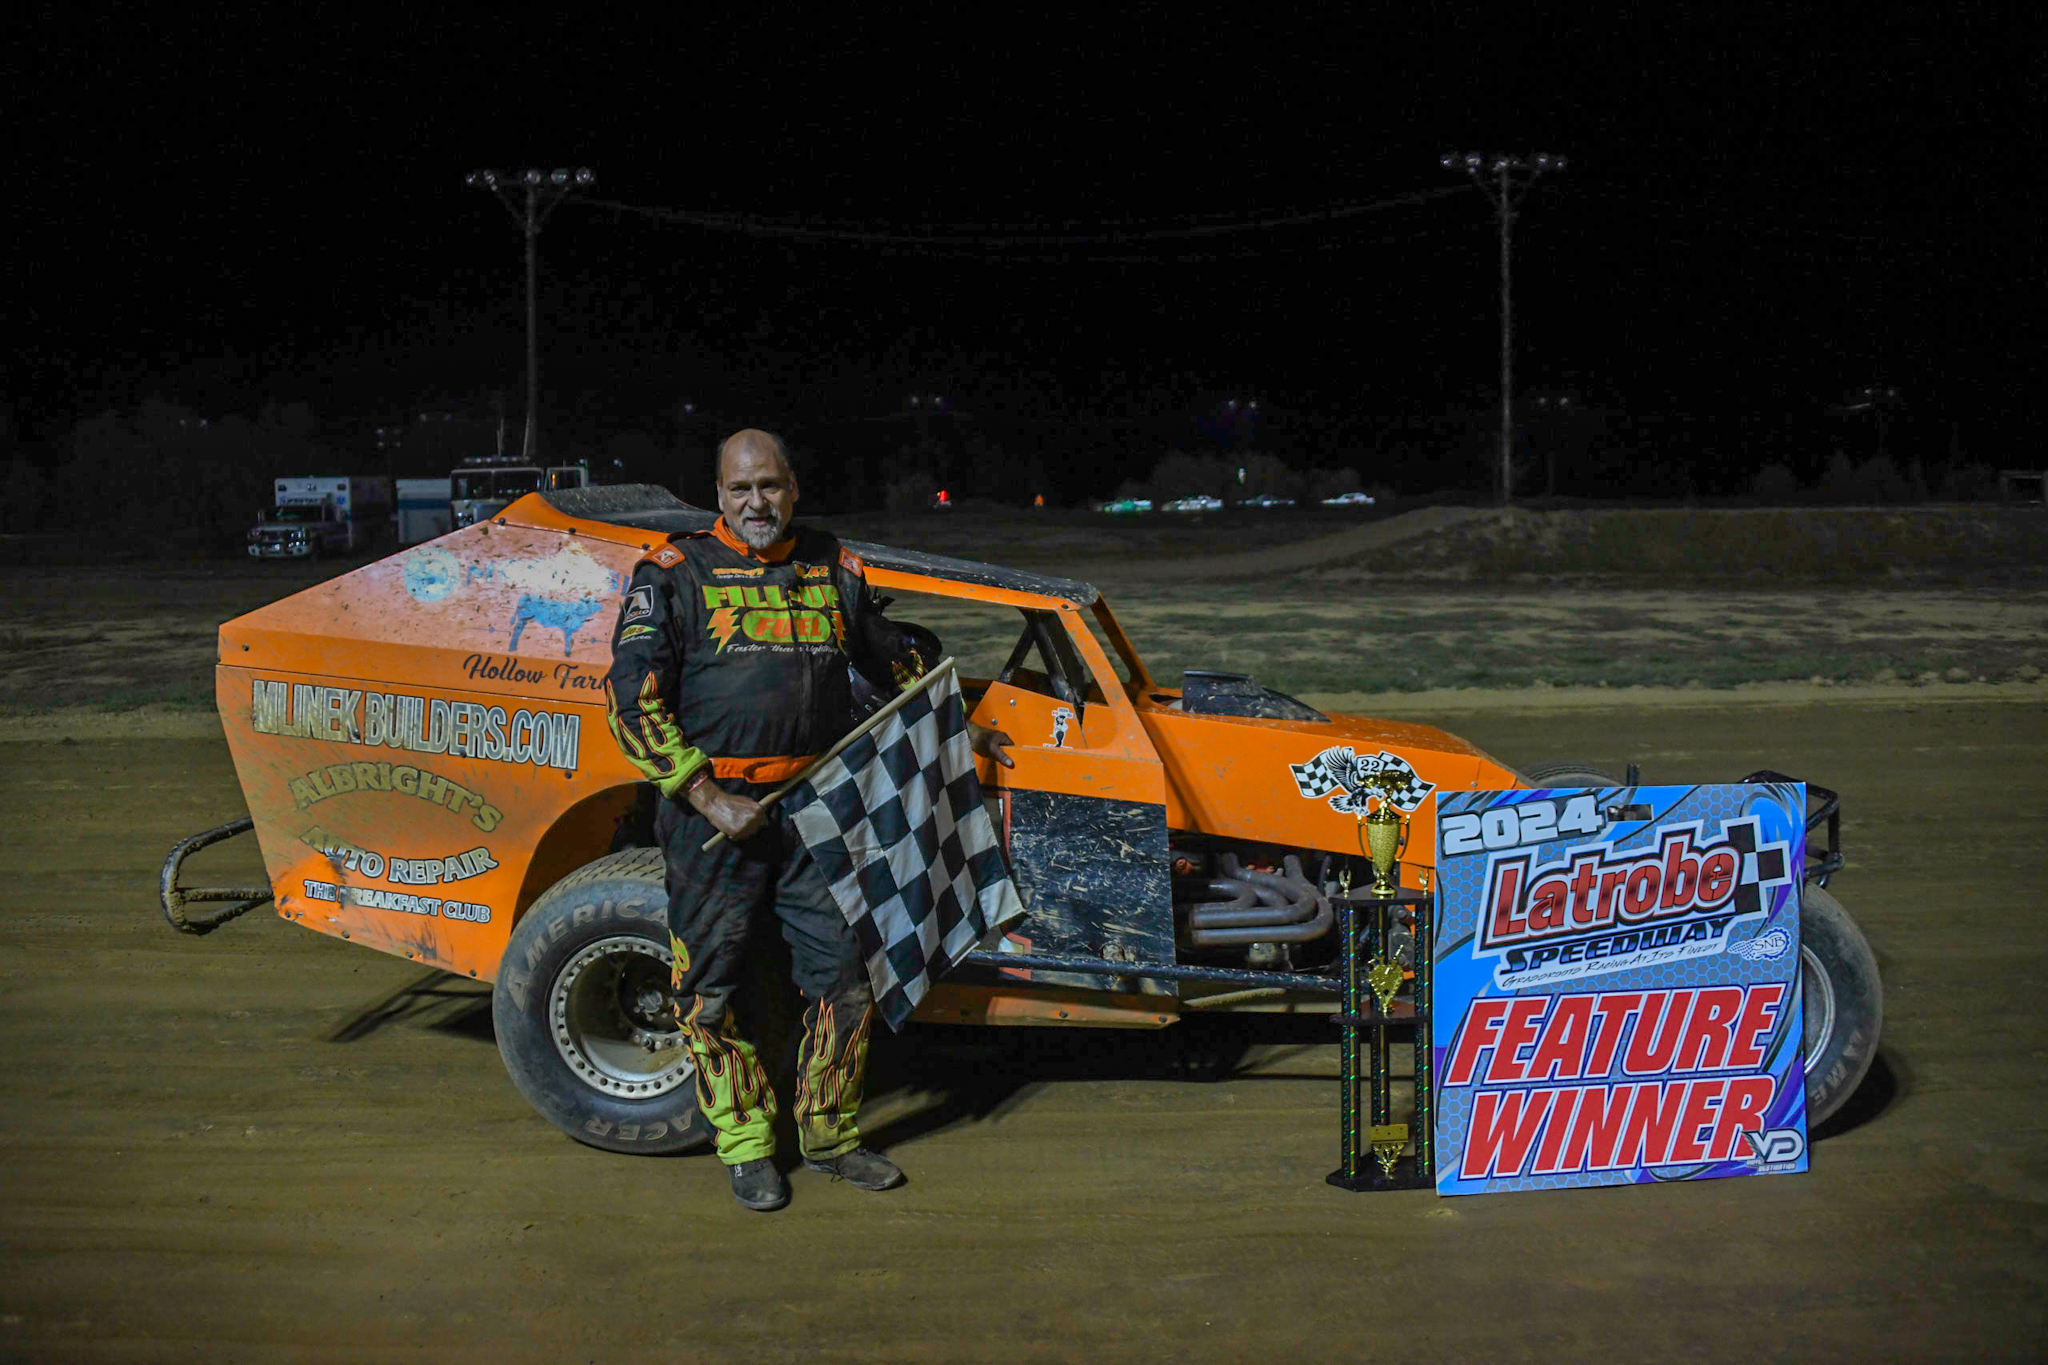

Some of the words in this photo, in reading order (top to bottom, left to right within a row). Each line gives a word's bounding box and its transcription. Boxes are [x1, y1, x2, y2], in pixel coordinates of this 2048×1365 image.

[726, 643, 766, 653] Faster
[753, 616, 823, 638] FUEL
[463, 653, 546, 683] Hollow
[1360, 759, 1380, 772] 22
[289, 762, 503, 832] ALBRIGHT'S
[1442, 795, 1602, 855] 2024
[300, 825, 384, 877] AUTO
[387, 847, 499, 884] REPAIR
[304, 879, 336, 901] THE
[442, 901, 491, 922] CLUB
[1491, 834, 1734, 938] Latrobe
[506, 897, 669, 1013] AMERICA
[1500, 917, 1732, 976] SPEEDWAY
[1753, 935, 1787, 951] SNB
[1444, 984, 1787, 1087] FEATURE
[583, 1107, 695, 1141] ACER
[1459, 1074, 1776, 1180] WINNER
